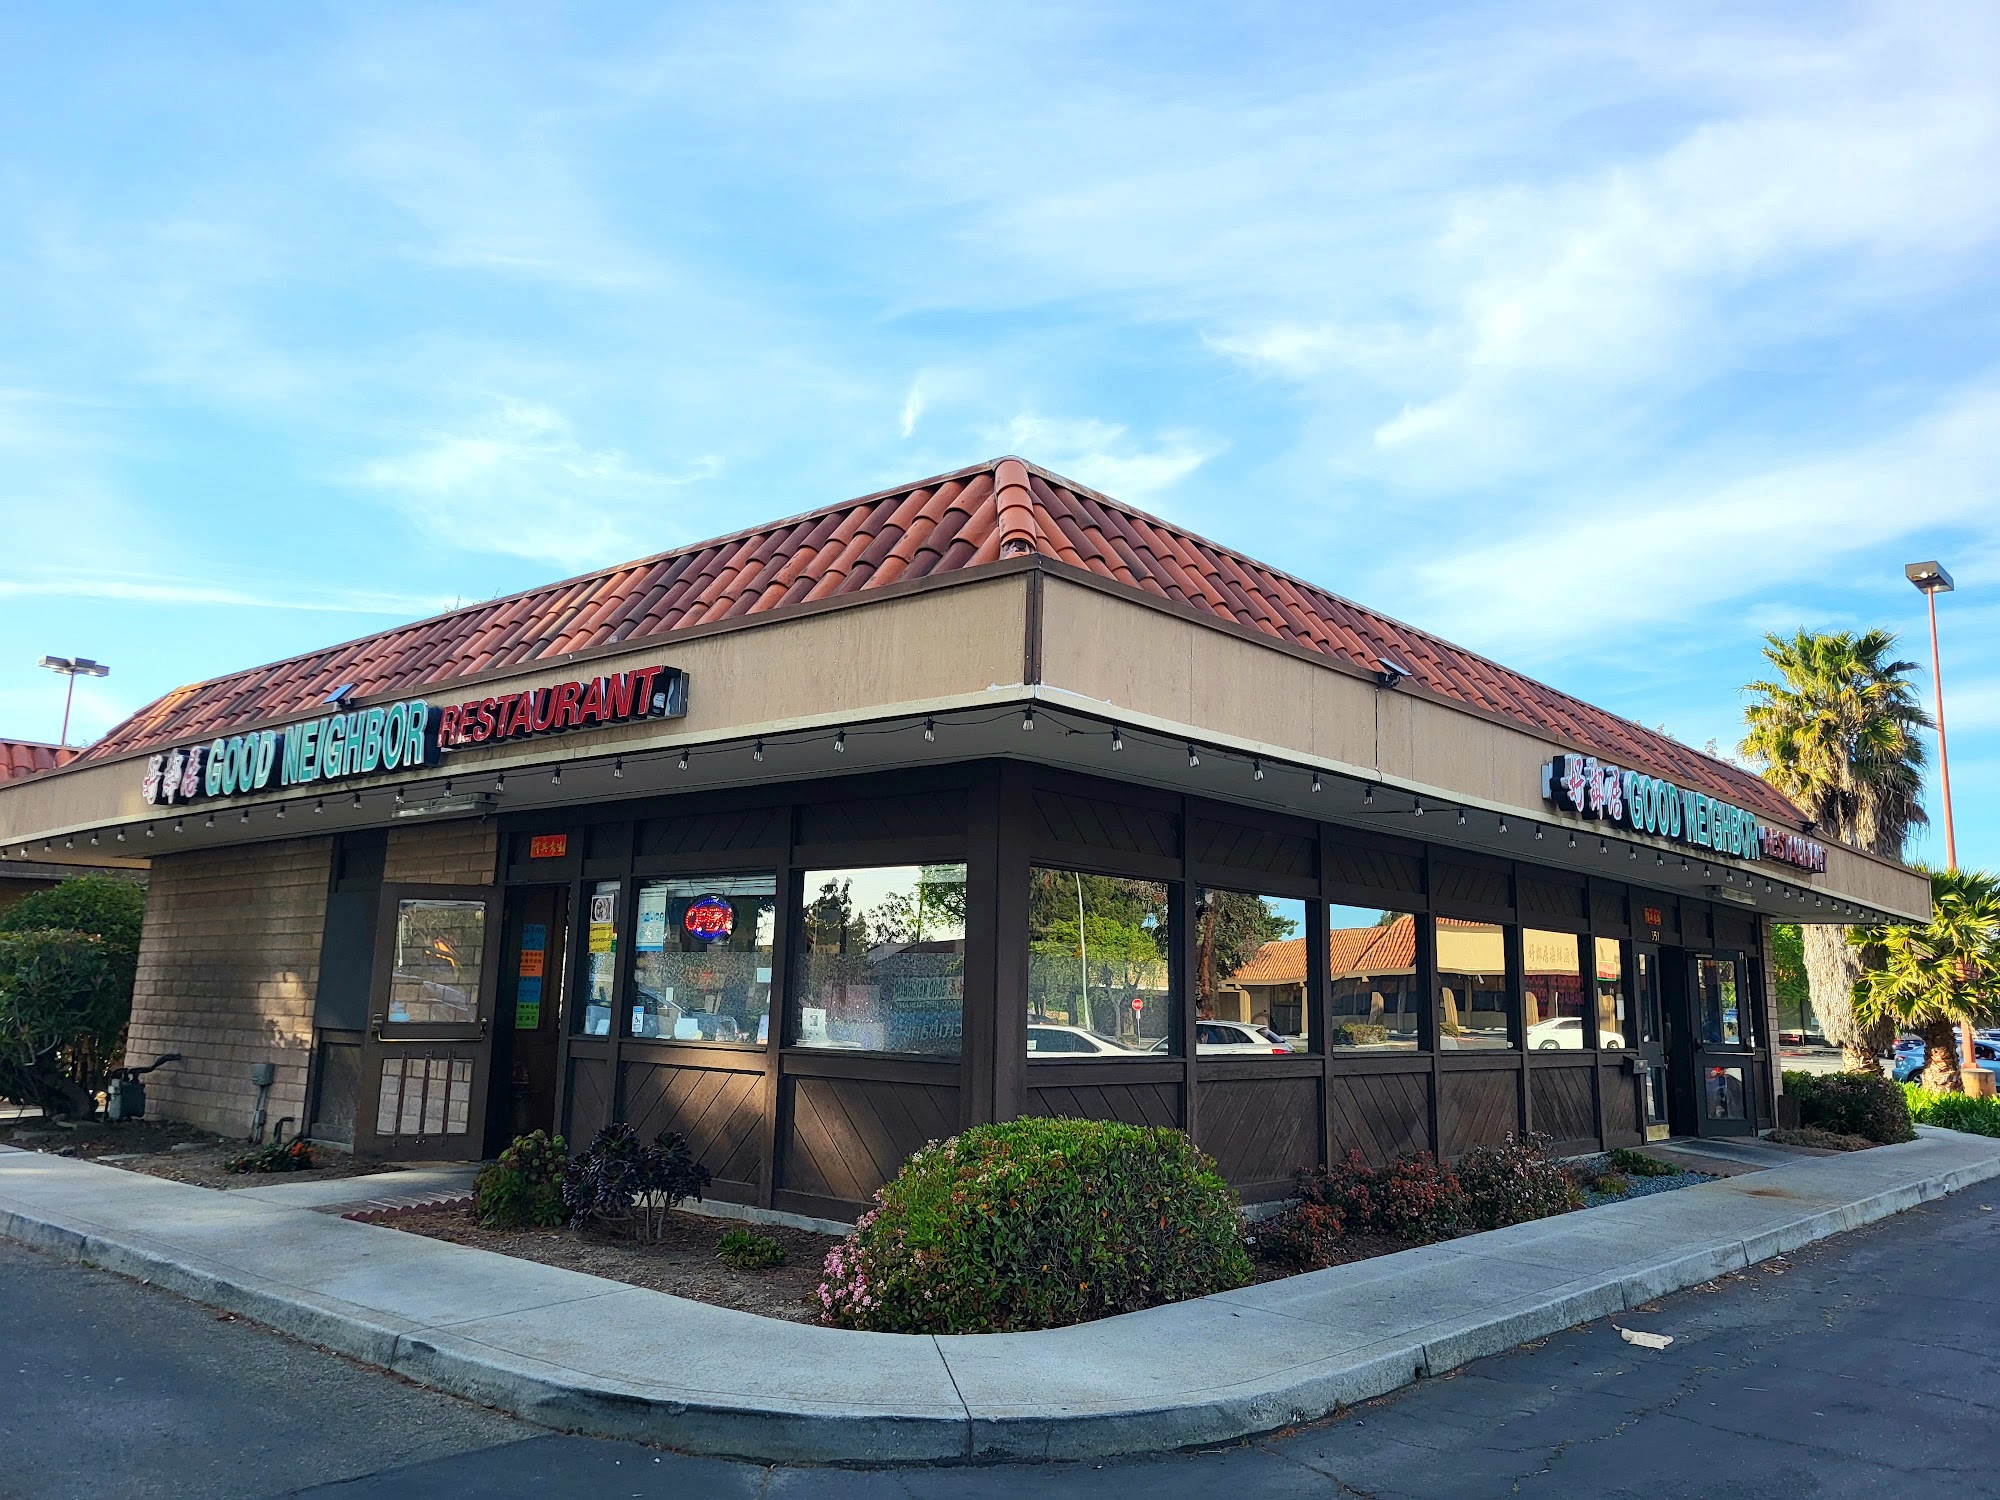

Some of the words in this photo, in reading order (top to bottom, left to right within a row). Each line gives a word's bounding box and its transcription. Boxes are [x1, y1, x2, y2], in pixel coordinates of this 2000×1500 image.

[205, 729, 277, 797] GOOD
[281, 698, 429, 786] NEIGHBOR
[436, 664, 664, 748] RESTAURANT
[1624, 769, 1681, 838] GOOD
[1681, 789, 1761, 861] NEIGHBOR
[1764, 825, 1829, 873] RESTAURANT
[685, 906, 733, 932] OPEN
